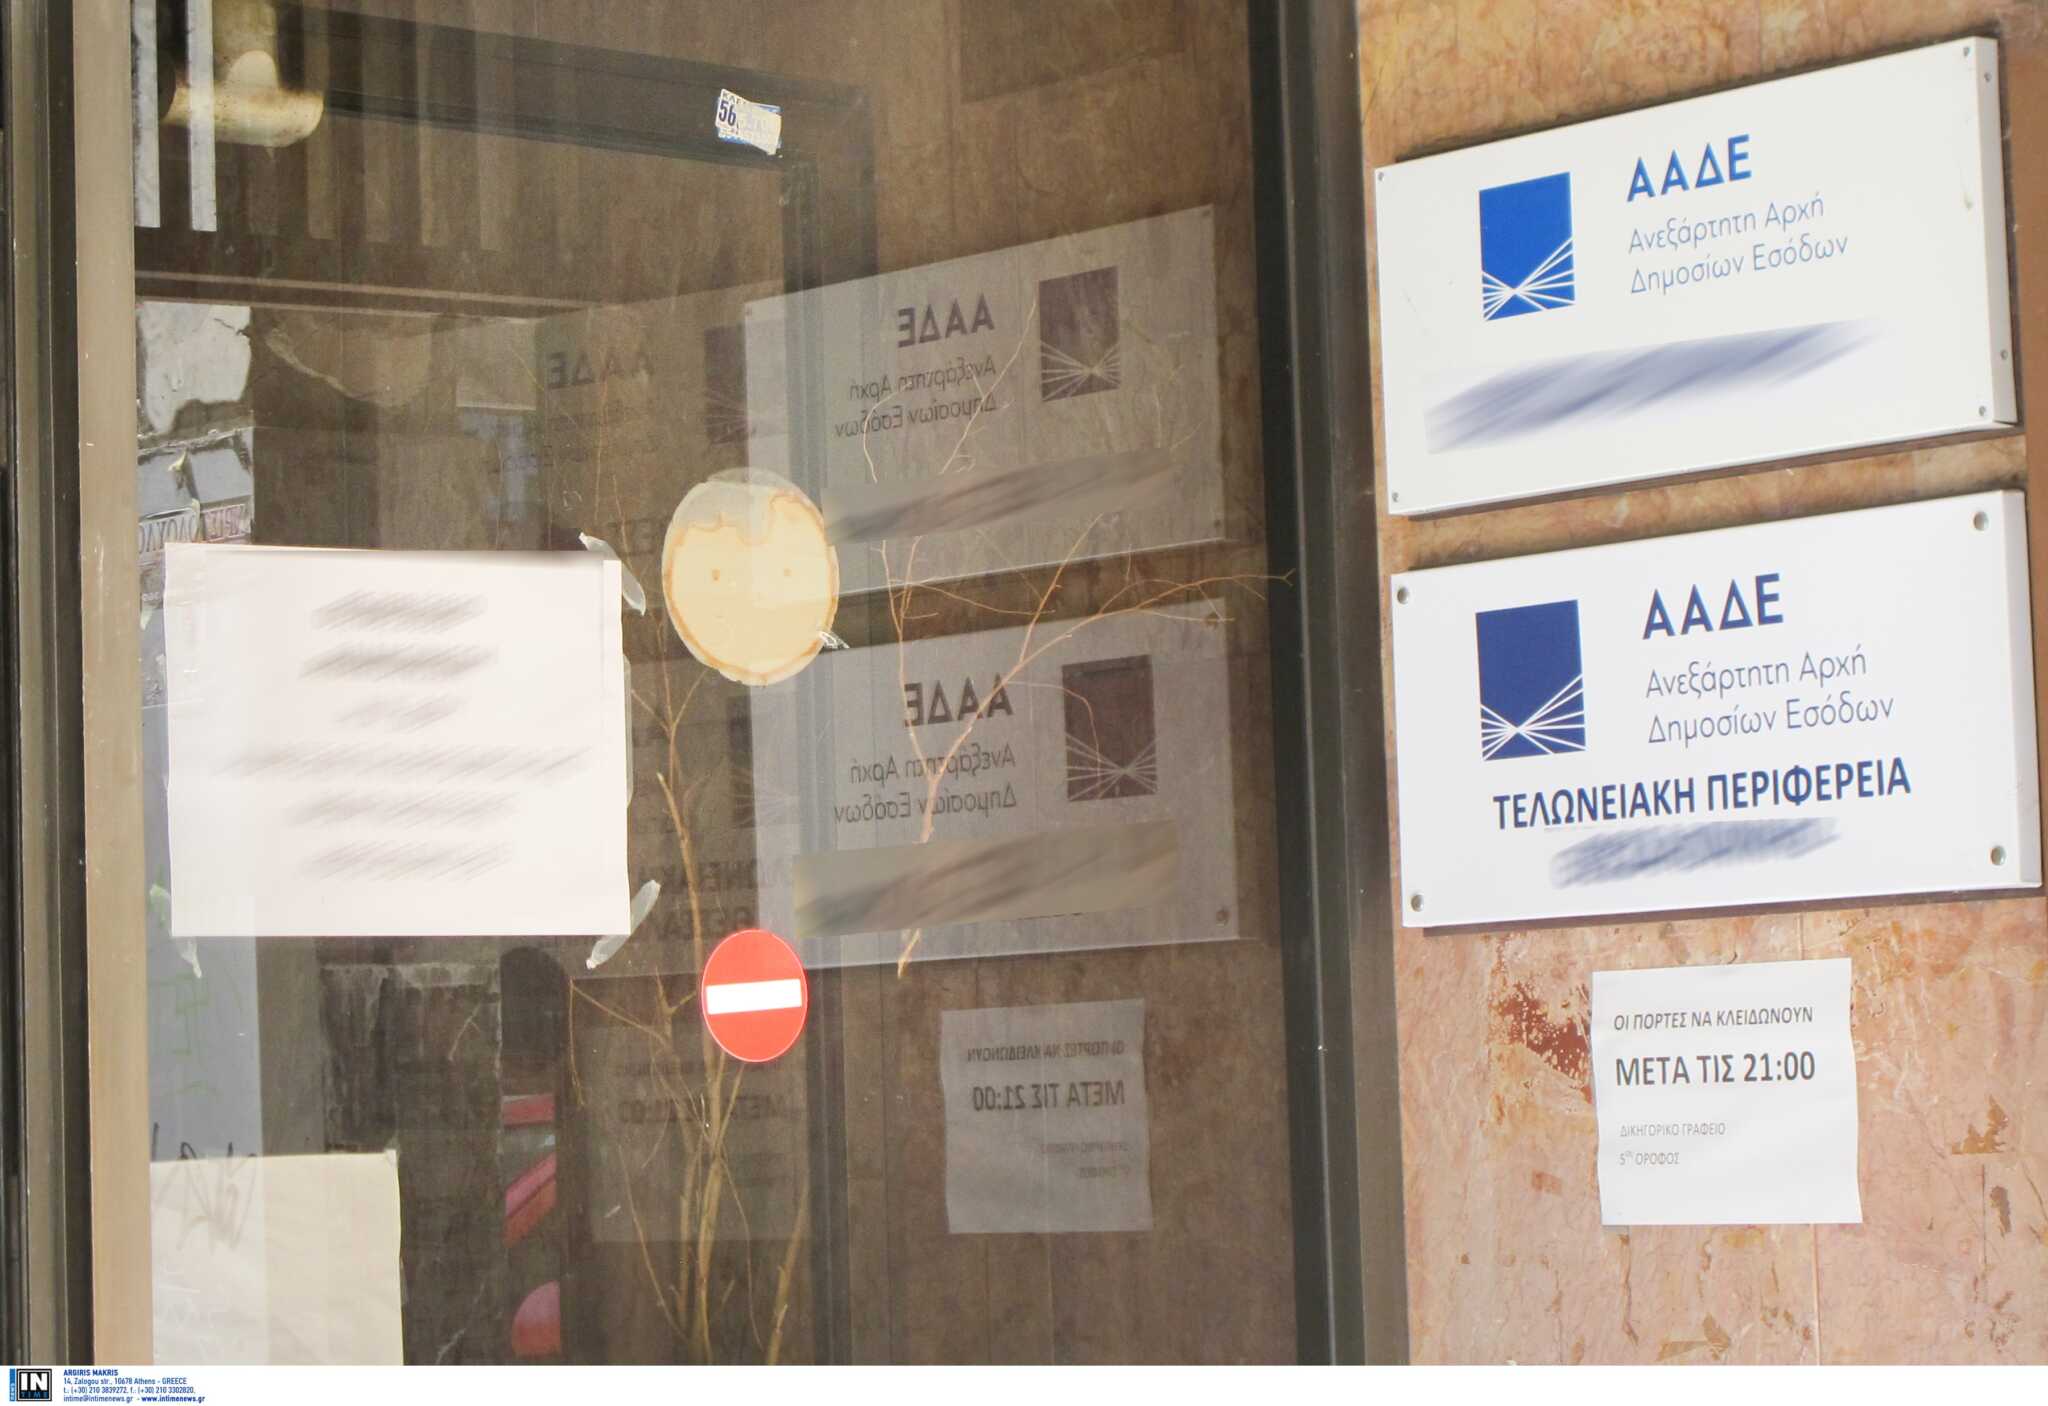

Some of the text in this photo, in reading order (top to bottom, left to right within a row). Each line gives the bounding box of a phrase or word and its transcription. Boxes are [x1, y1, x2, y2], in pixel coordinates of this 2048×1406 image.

[1627, 134, 1752, 202] ΑΑΔΕ
[1628, 191, 1824, 254] Ανεξάρτητη Αρχή
[1631, 232, 1848, 295] Δημοσίων Εσόδων
[1642, 573, 1783, 639] ΑΑΔΕ
[1646, 644, 1867, 700] Ανεξάρτητη Αρχή
[1648, 691, 1893, 748] Δημοσίων Εσόδων
[1493, 757, 1912, 829] ΤΕΛΩΝΕΙΑΚΗ ΠΕΡΙΦΕΡΕΙΑ
[1614, 1007, 1813, 1031] ΟΙ ΠΟΡΤΕΣ ΝΑ ΚΛΕΙΔΩΝΟΥΝ
[1615, 1051, 1815, 1086] ΜΕΤΑ ΤΙΣ 21:00
[1619, 1122, 1726, 1137] ΔΙΚΗΓΟΡΙΚΟ ΓΡΑΦΕΙΟ
[1634, 1152, 1680, 1166] ΟΡΟΦΟΣ
